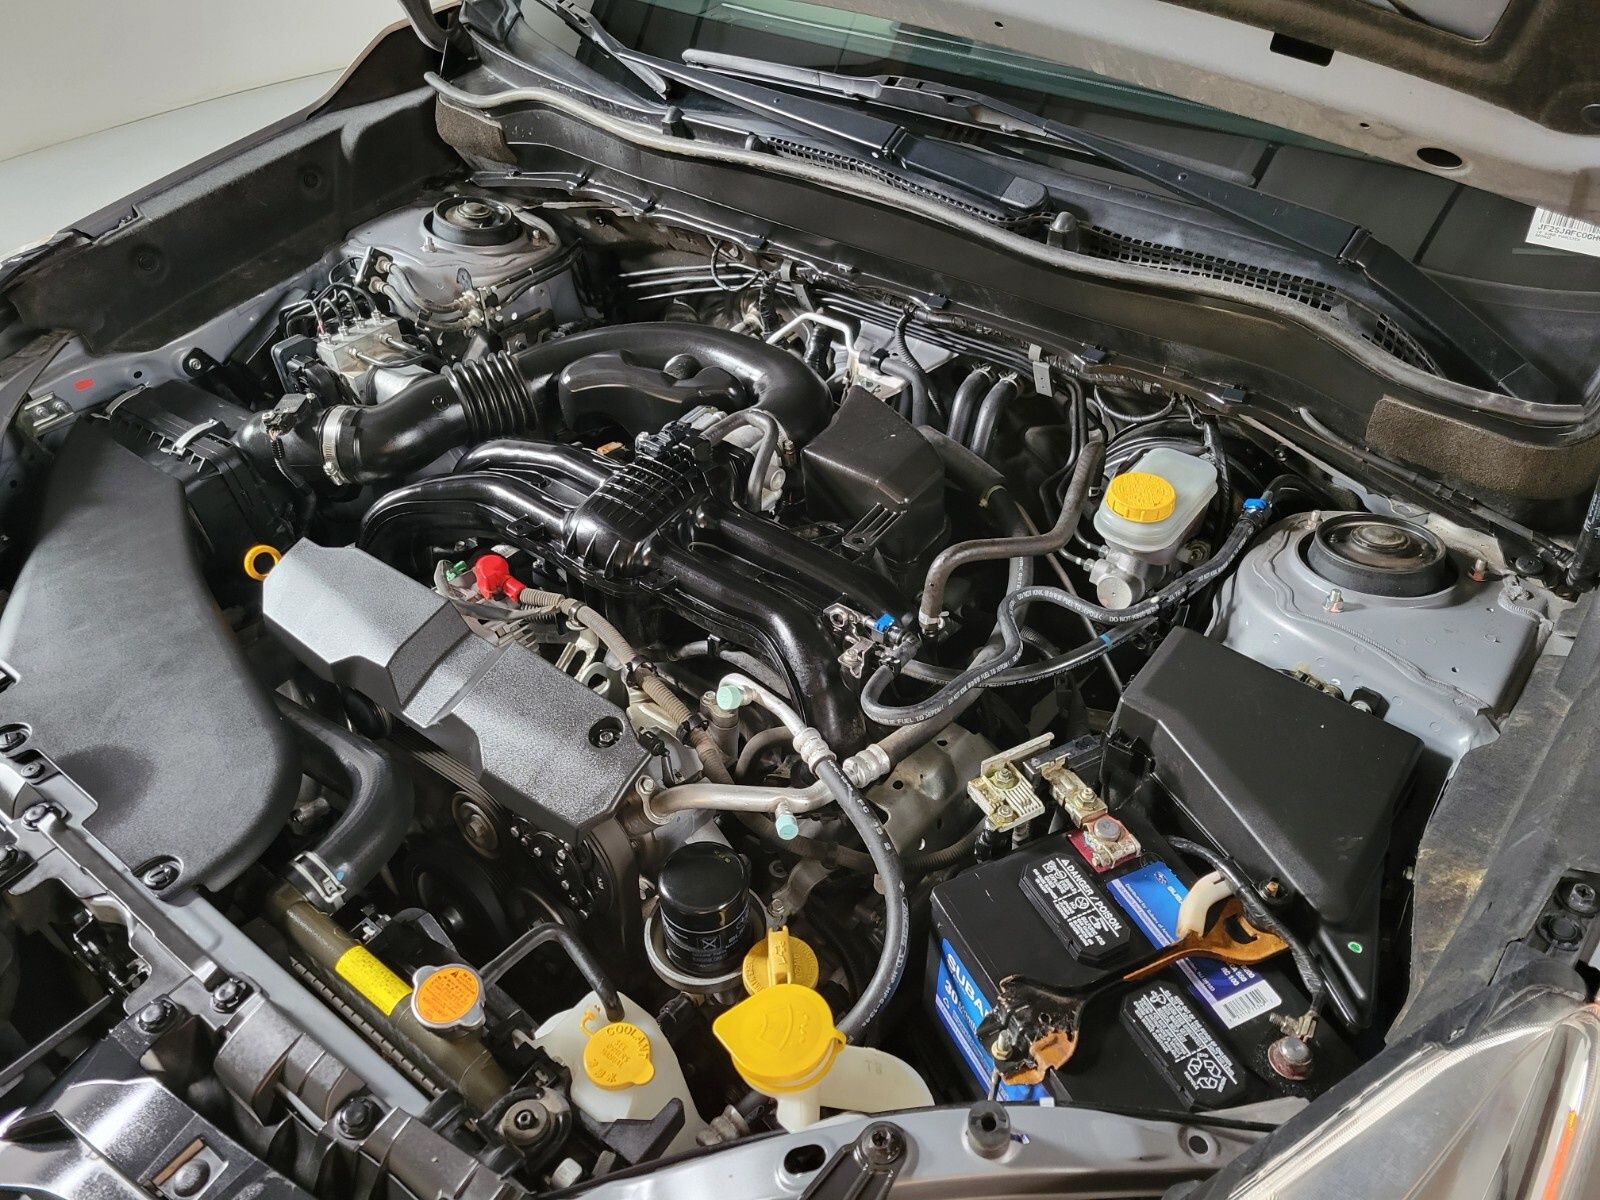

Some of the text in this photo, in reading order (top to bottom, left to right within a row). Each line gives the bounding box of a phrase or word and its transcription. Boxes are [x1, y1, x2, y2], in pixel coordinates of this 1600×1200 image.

[1066, 865, 1095, 896] DANGER
[1094, 900, 1122, 931] POISON
[944, 979, 959, 1005] 30
[606, 1024, 649, 1060] COOLANT
